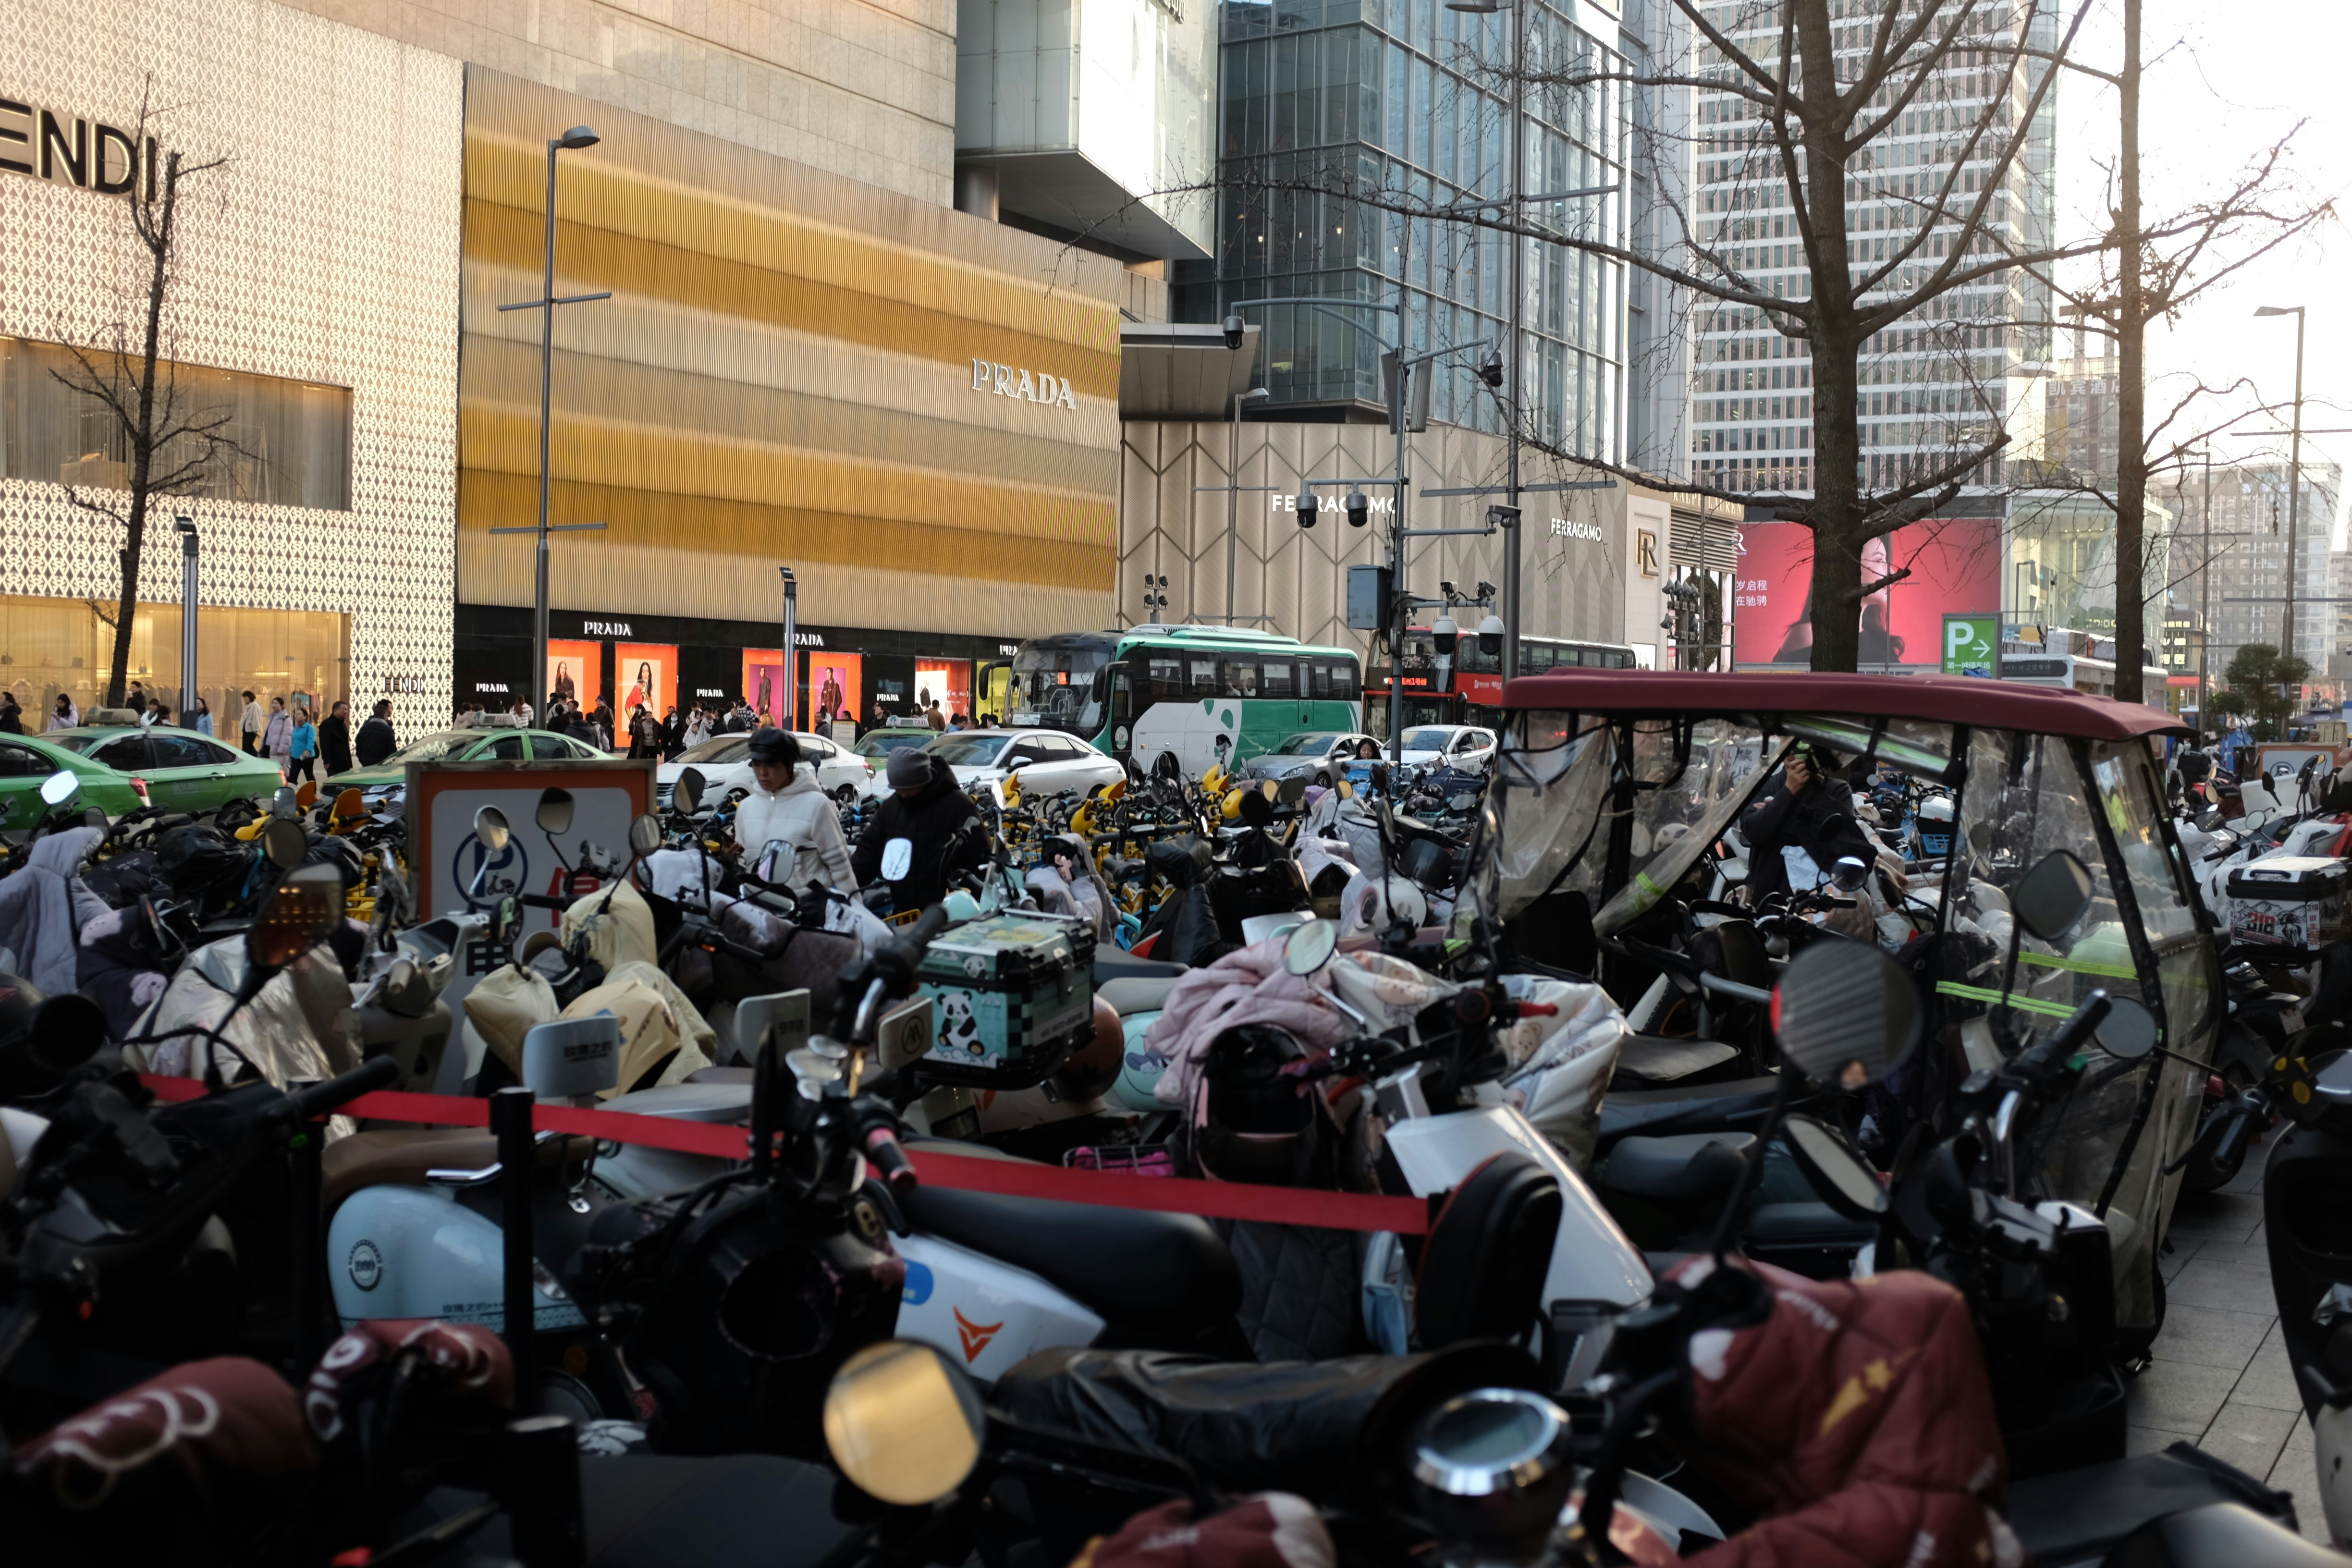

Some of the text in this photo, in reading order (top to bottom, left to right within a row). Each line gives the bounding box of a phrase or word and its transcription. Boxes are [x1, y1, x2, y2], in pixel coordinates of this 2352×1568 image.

[972, 358, 1077, 410] PRADA
[1551, 518, 1602, 542] FERRAGAMO
[584, 621, 633, 636] PRADA
[784, 632, 824, 646] RADA
[1948, 622, 1974, 658] P
[1000, 645, 1018, 656] PRA
[384, 677, 424, 693] FENDI
[476, 683, 508, 692] PRADA
[697, 689, 723, 697] PRADA
[877, 693, 899, 701] PRADA
